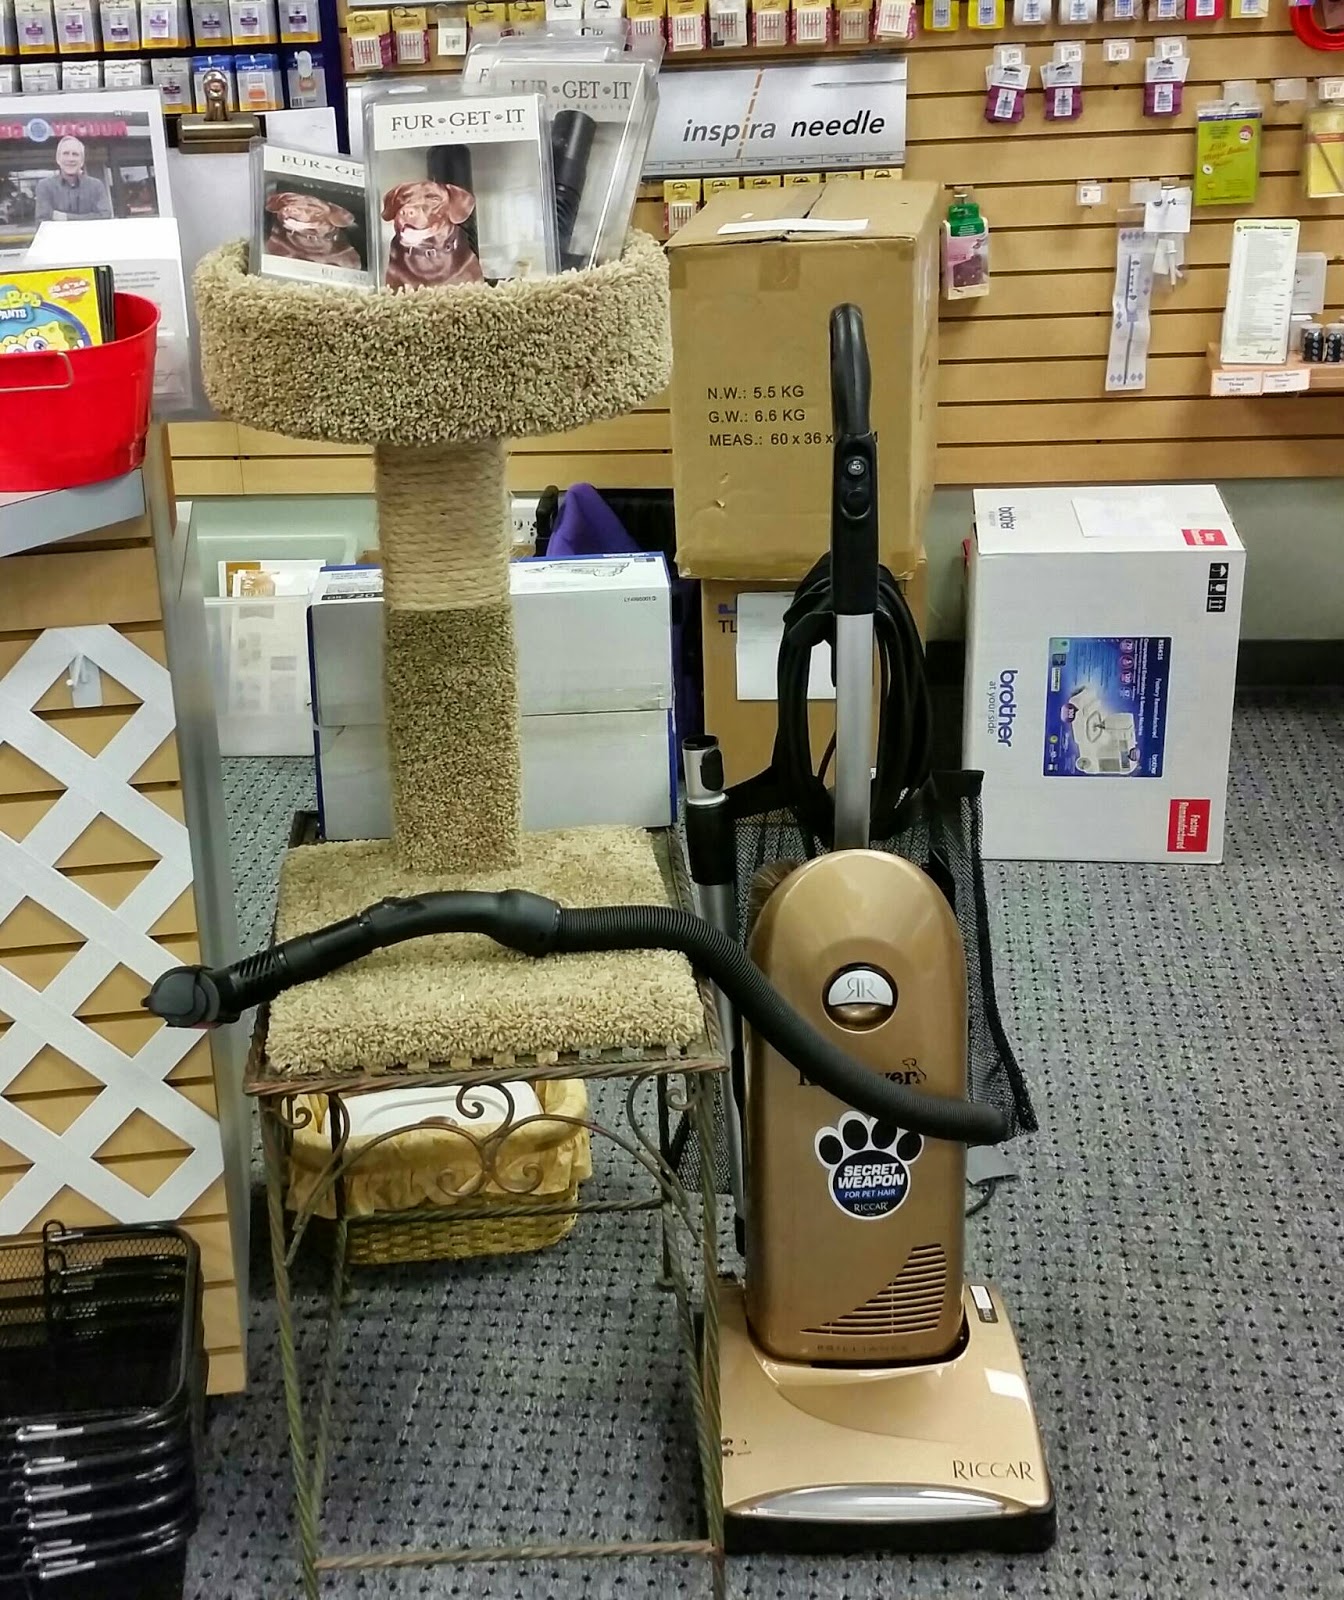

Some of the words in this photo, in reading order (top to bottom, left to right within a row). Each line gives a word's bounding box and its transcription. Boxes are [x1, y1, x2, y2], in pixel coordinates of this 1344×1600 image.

[562, 80, 600, 99] GET
[612, 81, 632, 99] IT
[391, 114, 435, 132] FUR
[449, 110, 491, 127] GET
[506, 108, 526, 124] IT
[682, 118, 777, 147] inspira
[790, 109, 886, 138] needle
[281, 154, 320, 169] FUR
[707, 386, 747, 400] N.W.:
[753, 386, 776, 399] 5.5
[781, 385, 805, 398] KG
[708, 410, 748, 424] G.W.:
[754, 410, 778, 423] 6.6
[782, 409, 806, 422] KG
[709, 433, 763, 447] MEAS.:
[770, 433, 789, 446] 60
[792, 436, 801, 445] x
[804, 432, 822, 445] 36
[989, 680, 997, 690] at
[1153, 677, 1162, 697] Factory
[986, 691, 996, 713] your
[997, 669, 1018, 748] brother
[987, 713, 997, 735] side
[1152, 697, 1161, 739] Remanufactured
[1151, 753, 1159, 775] brother
[1176, 801, 1190, 850] Remanufactured
[1187, 814, 1201, 837] Factory
[843, 1162, 900, 1177] SECRET
[837, 1173, 906, 1189] WEAPON
[844, 1191, 860, 1199] FOR
[862, 1189, 876, 1198] PET
[877, 1188, 896, 1197] HAIR
[853, 1201, 889, 1213] RICCAR
[952, 1459, 1037, 1482] RICCAR
